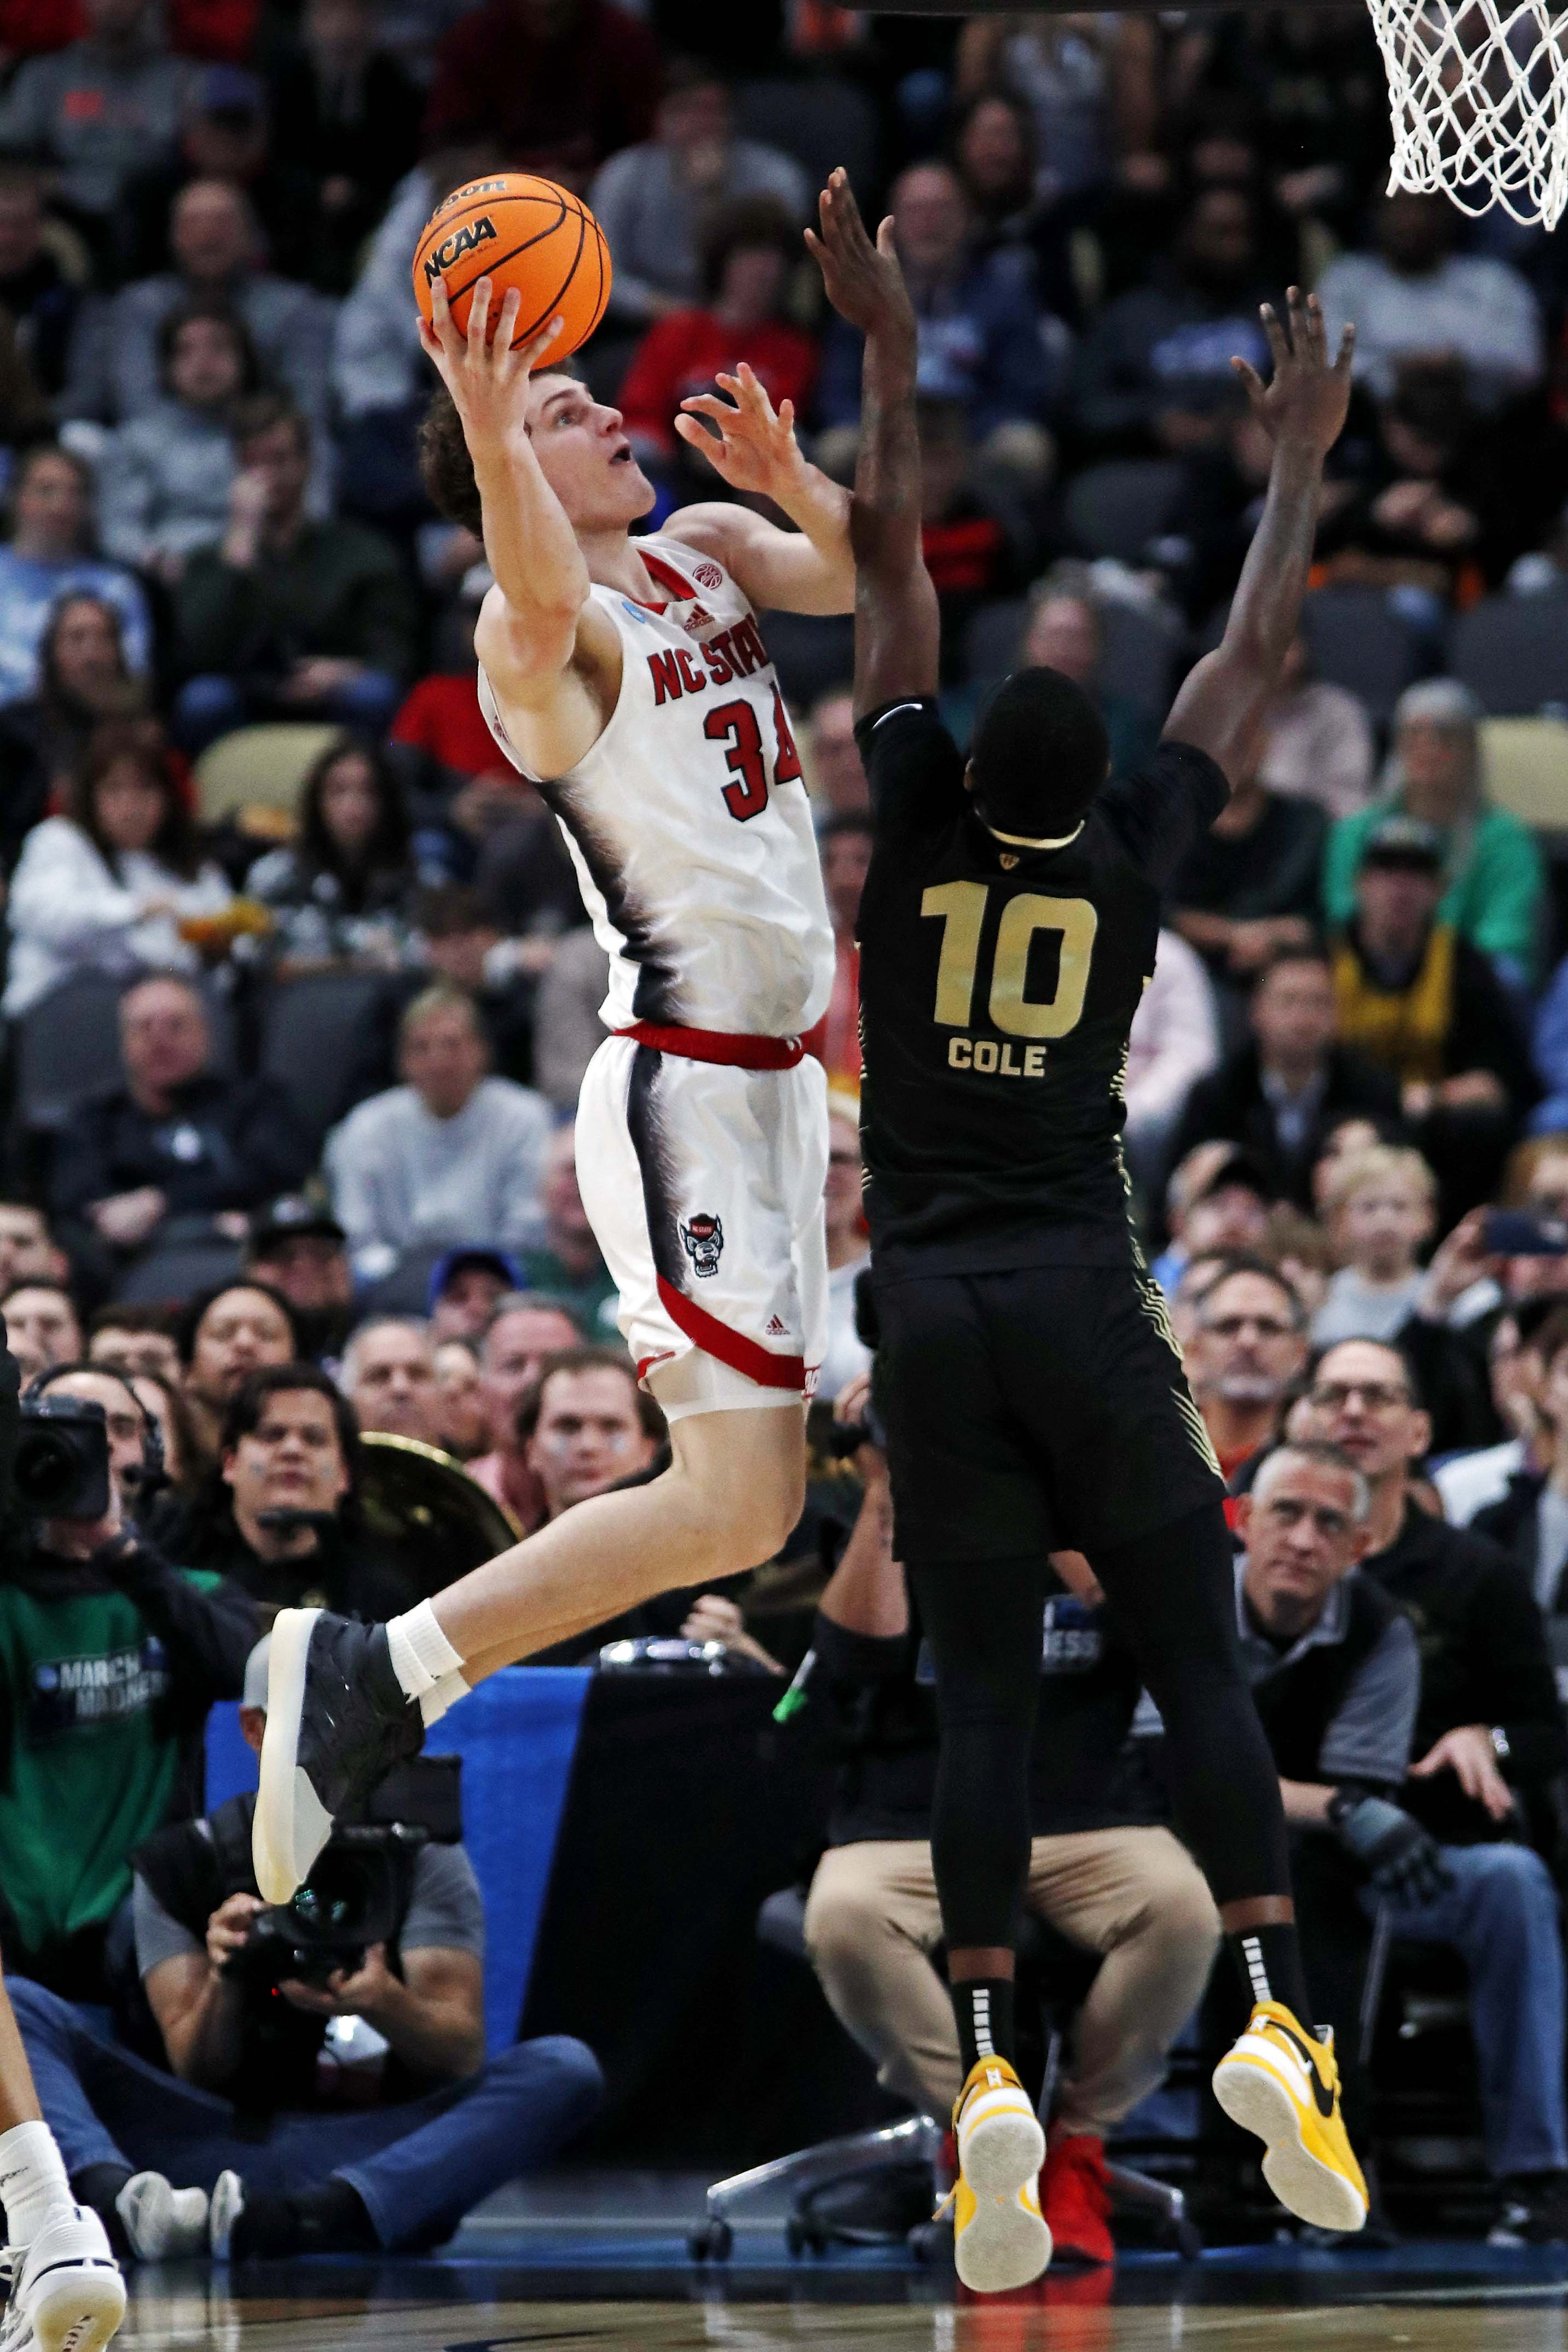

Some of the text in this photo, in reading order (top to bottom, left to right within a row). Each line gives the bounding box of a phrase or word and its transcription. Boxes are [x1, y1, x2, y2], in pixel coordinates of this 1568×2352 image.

[424, 216, 498, 289] NCAA
[647, 612, 771, 706] NC STA
[920, 880, 1098, 1039] 10
[947, 1037, 1048, 1078] COLE
[60, 1653, 141, 1690] MARCH
